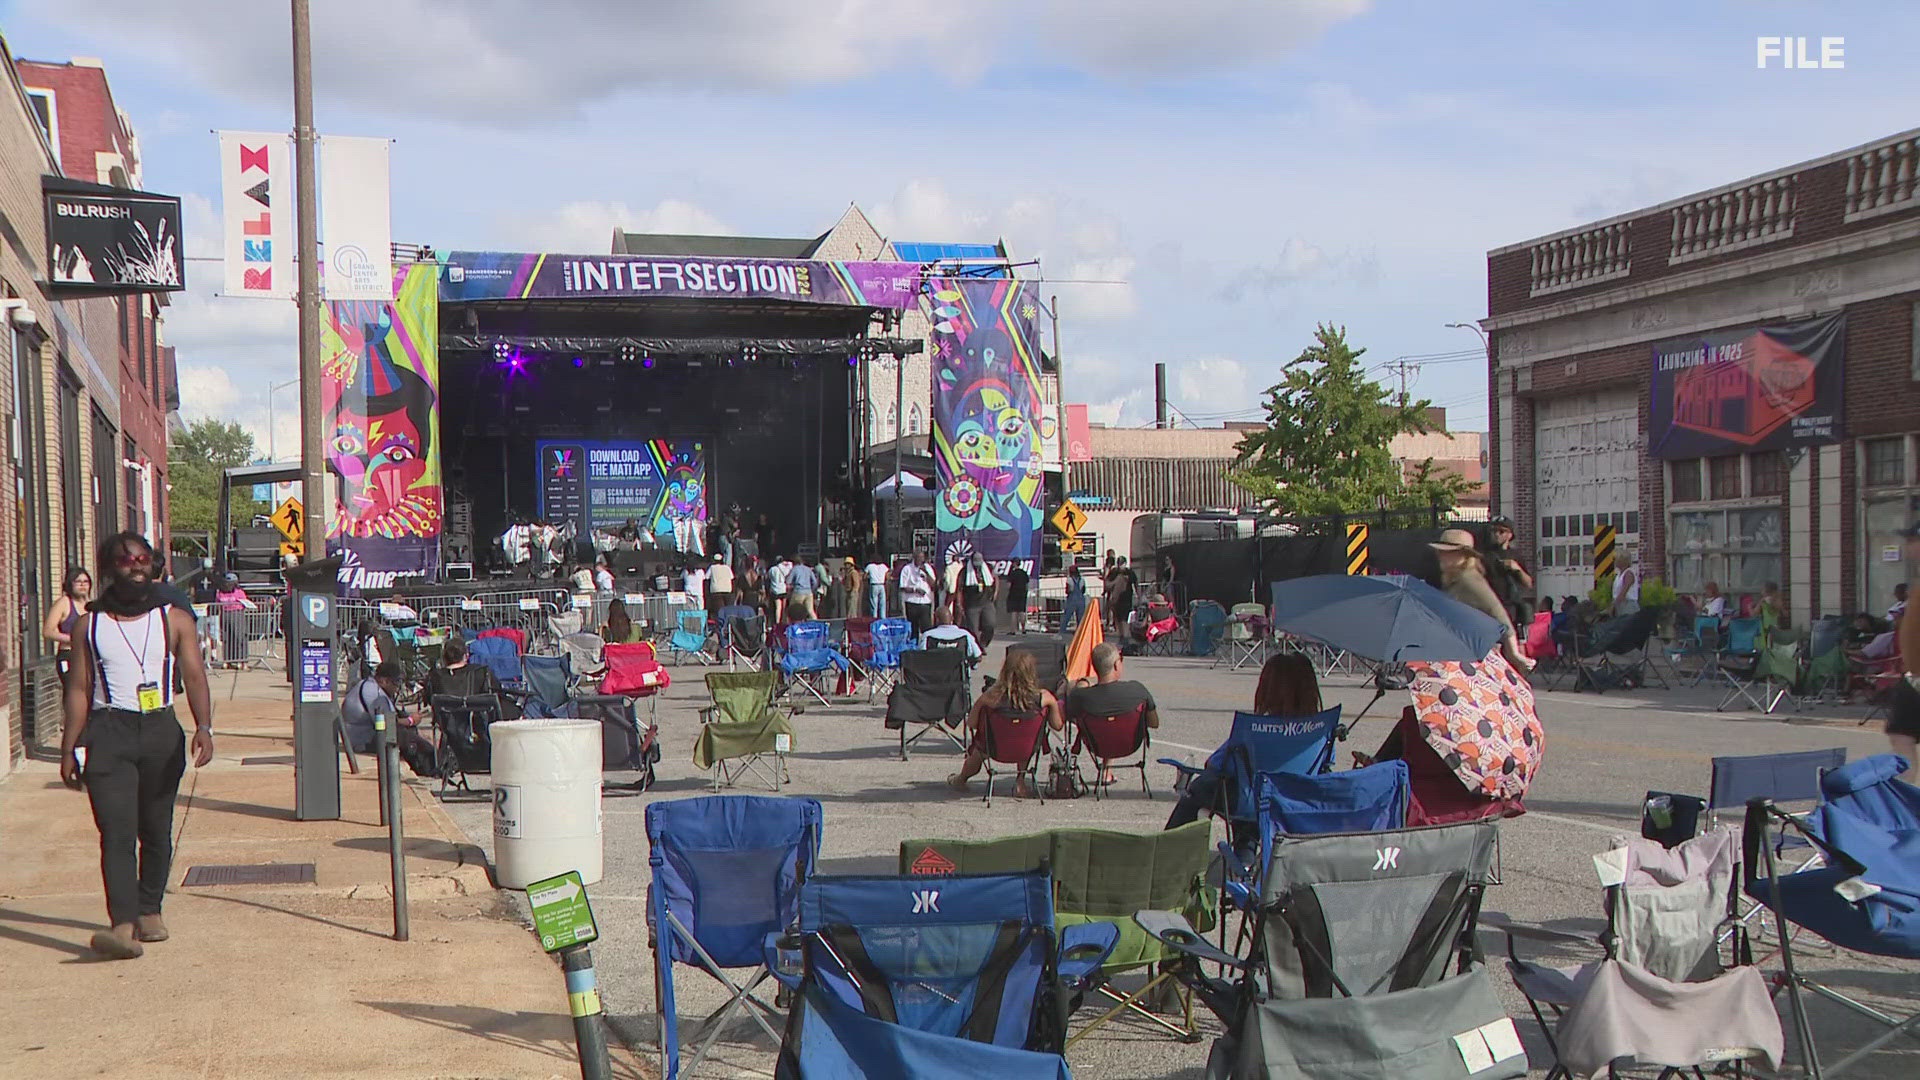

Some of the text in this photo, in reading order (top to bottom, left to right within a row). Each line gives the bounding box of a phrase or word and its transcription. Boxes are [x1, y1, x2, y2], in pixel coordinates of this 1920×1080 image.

[56, 202, 131, 219] BULRUSH
[240, 143, 271, 290] RELAX
[572, 261, 798, 294] INTERSECTION
[795, 266, 812, 296] 2024
[1658, 342, 1743, 372] LAUNCHING IN 2025
[590, 450, 640, 463] DOWNLOAD
[590, 463, 609, 476] THE
[609, 463, 632, 476] MATI
[633, 463, 651, 476] APP
[607, 488, 624, 497] SCAN
[635, 488, 651, 497] CODE
[607, 496, 647, 505] TO DOWNLOAD
[309, 598, 326, 622] P
[1251, 723, 1284, 733] DANTE'S
[911, 866, 956, 875] KELTY
